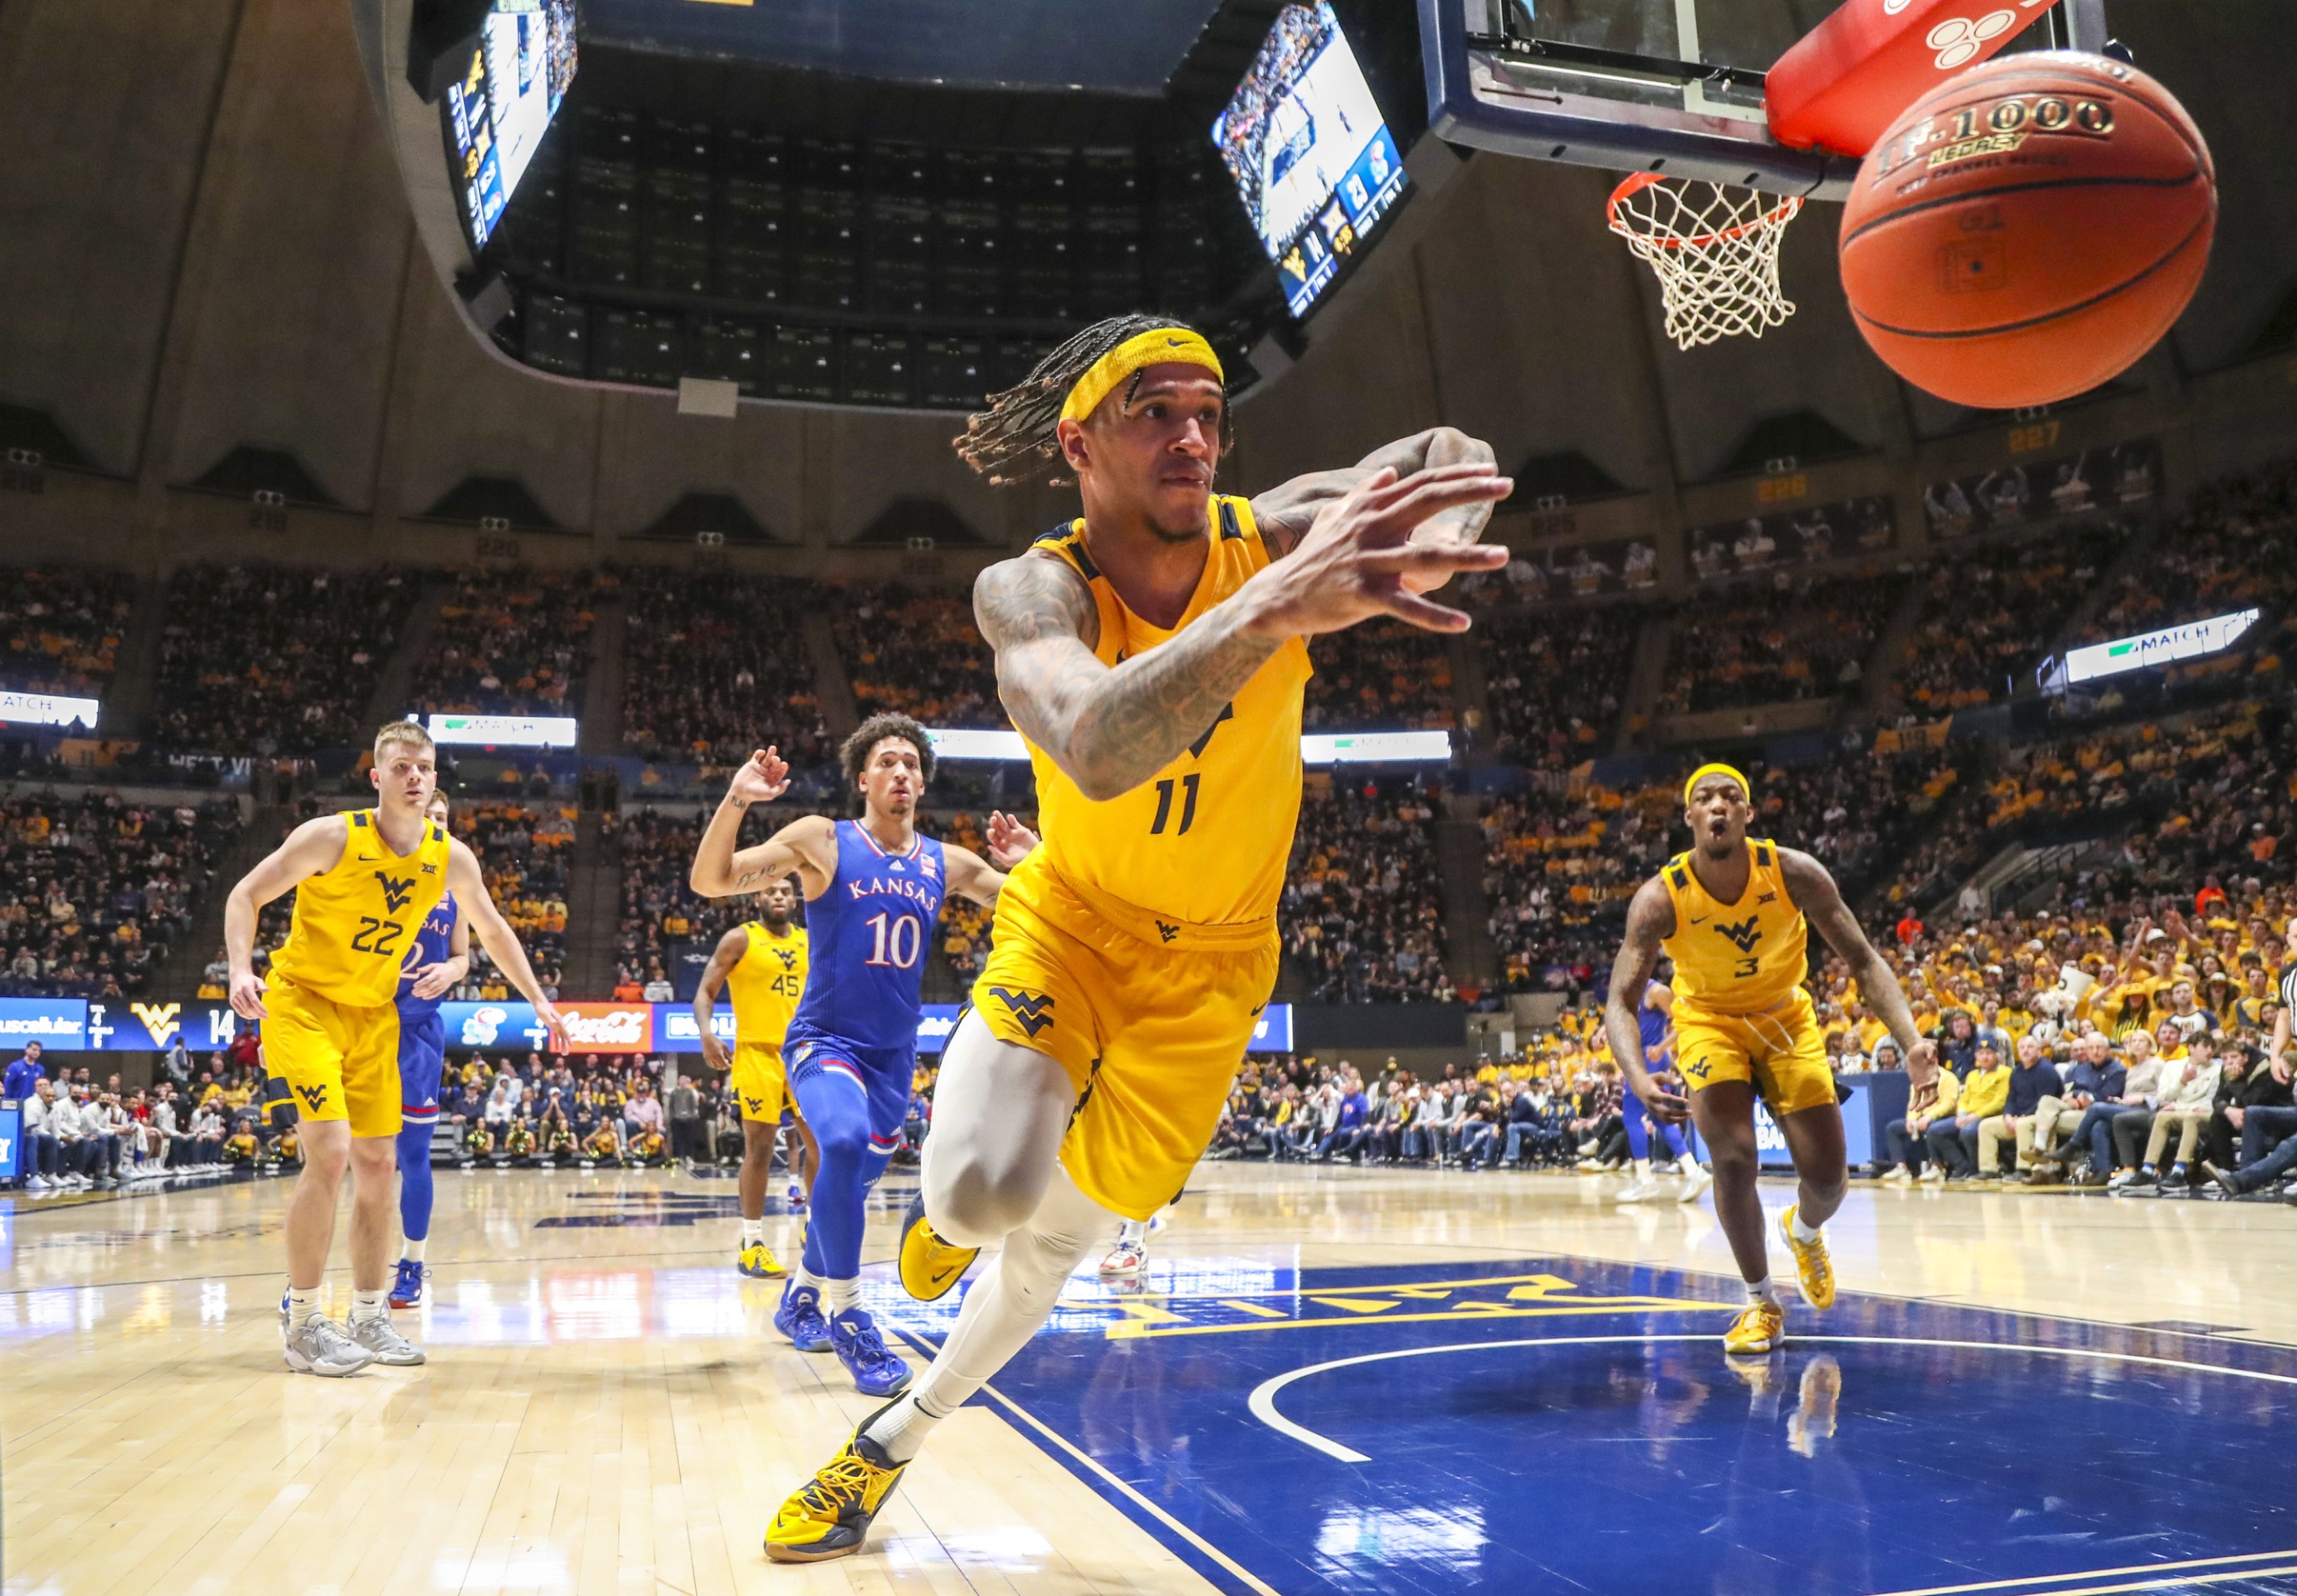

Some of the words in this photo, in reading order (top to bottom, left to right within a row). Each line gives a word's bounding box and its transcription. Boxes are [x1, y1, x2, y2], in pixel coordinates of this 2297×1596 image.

[1927, 133, 2028, 169] LEGACY
[2142, 625, 2210, 651] MATCH
[1150, 773, 1201, 836] 11
[848, 877, 937, 910] KANSAS
[350, 916, 404, 956] 22
[865, 912, 921, 968] 10
[770, 974, 799, 997] 45
[1734, 957, 1759, 978] 3
[210, 1009, 235, 1045] 14
